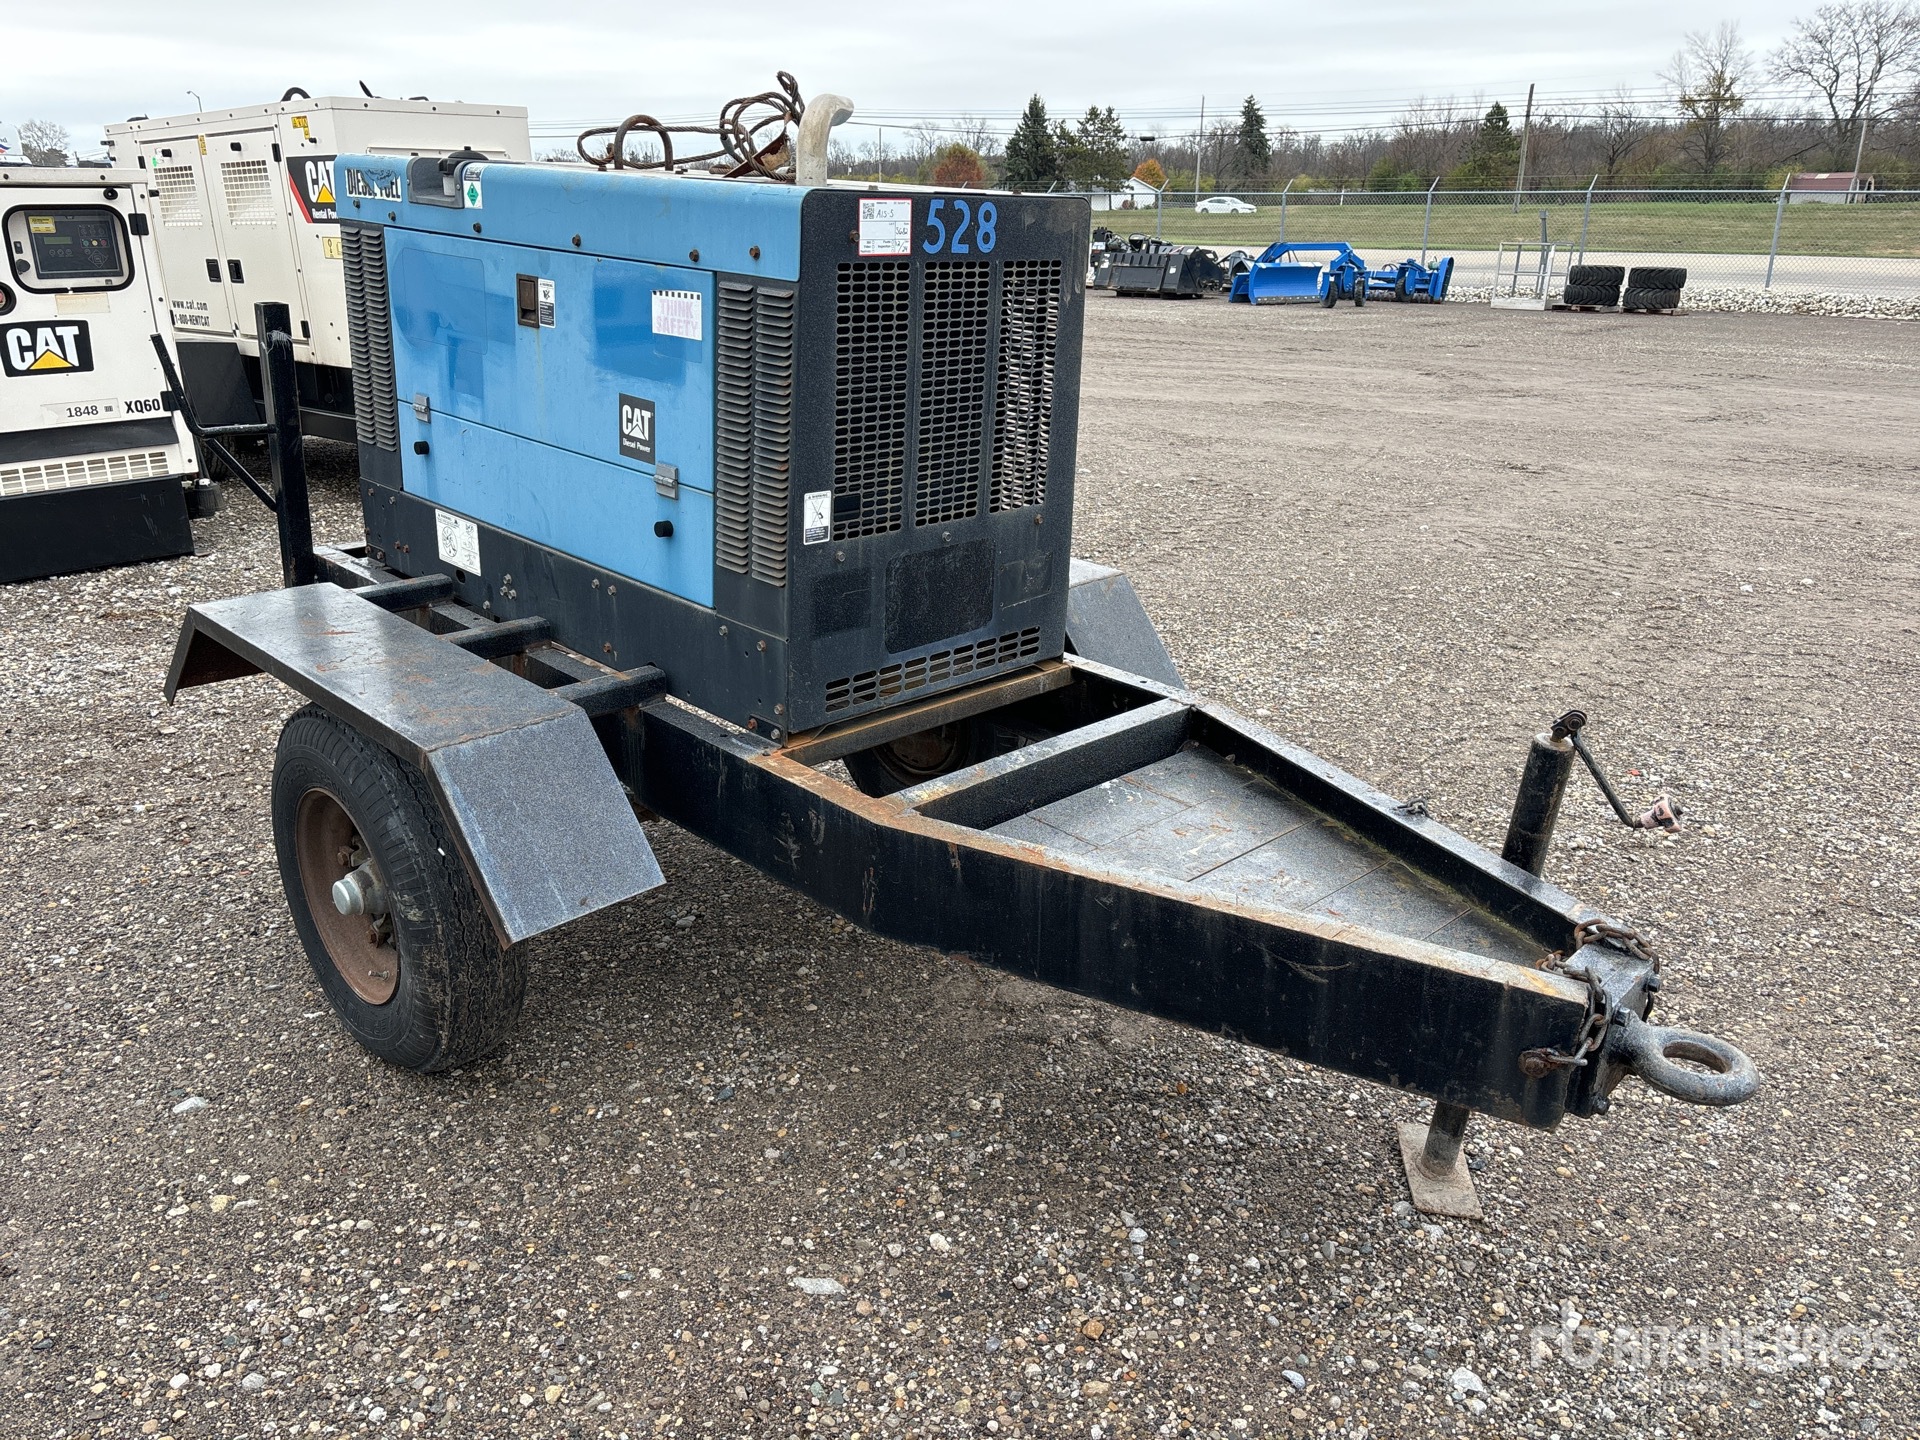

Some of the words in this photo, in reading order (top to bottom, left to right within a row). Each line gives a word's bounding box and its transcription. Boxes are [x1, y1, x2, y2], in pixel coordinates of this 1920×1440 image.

[305, 161, 337, 203] CAT
[346, 168, 377, 196] DIES
[922, 199, 998, 255] 528
[172, 300, 208, 311] www.cat.com
[660, 299, 694, 319] THINK
[656, 316, 699, 338] SAFETY
[6, 326, 80, 371] CAT
[66, 405, 99, 418] 1848
[124, 399, 161, 414] XQ60
[622, 404, 652, 441] CAT
[622, 437, 636, 449] Diesel
[636, 441, 651, 453] Power
